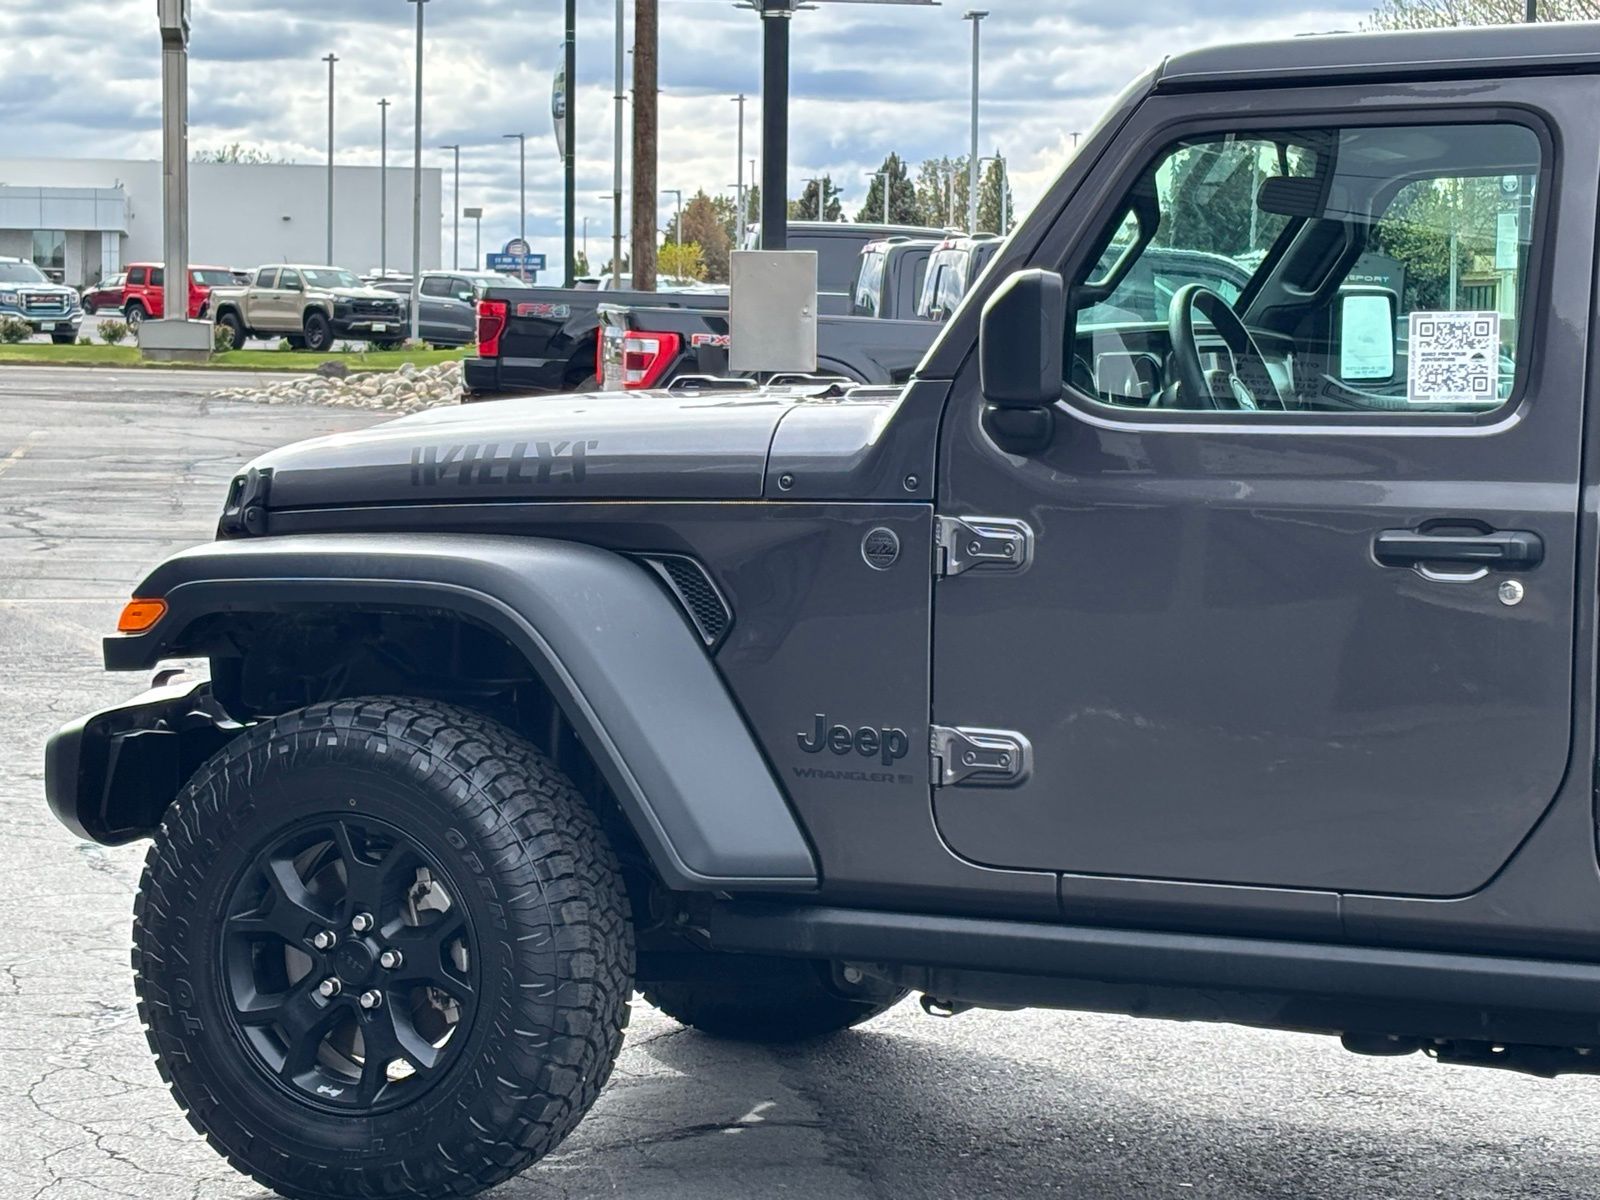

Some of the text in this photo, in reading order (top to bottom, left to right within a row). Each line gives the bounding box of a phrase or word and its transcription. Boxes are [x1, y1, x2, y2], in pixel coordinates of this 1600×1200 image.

[516, 302, 571, 319] FX4
[690, 332, 730, 348] FX
[410, 440, 599, 486] WILLYS
[796, 713, 910, 767] Jeep
[791, 767, 896, 784] WRANGLER
[444, 825, 508, 930] OPEN
